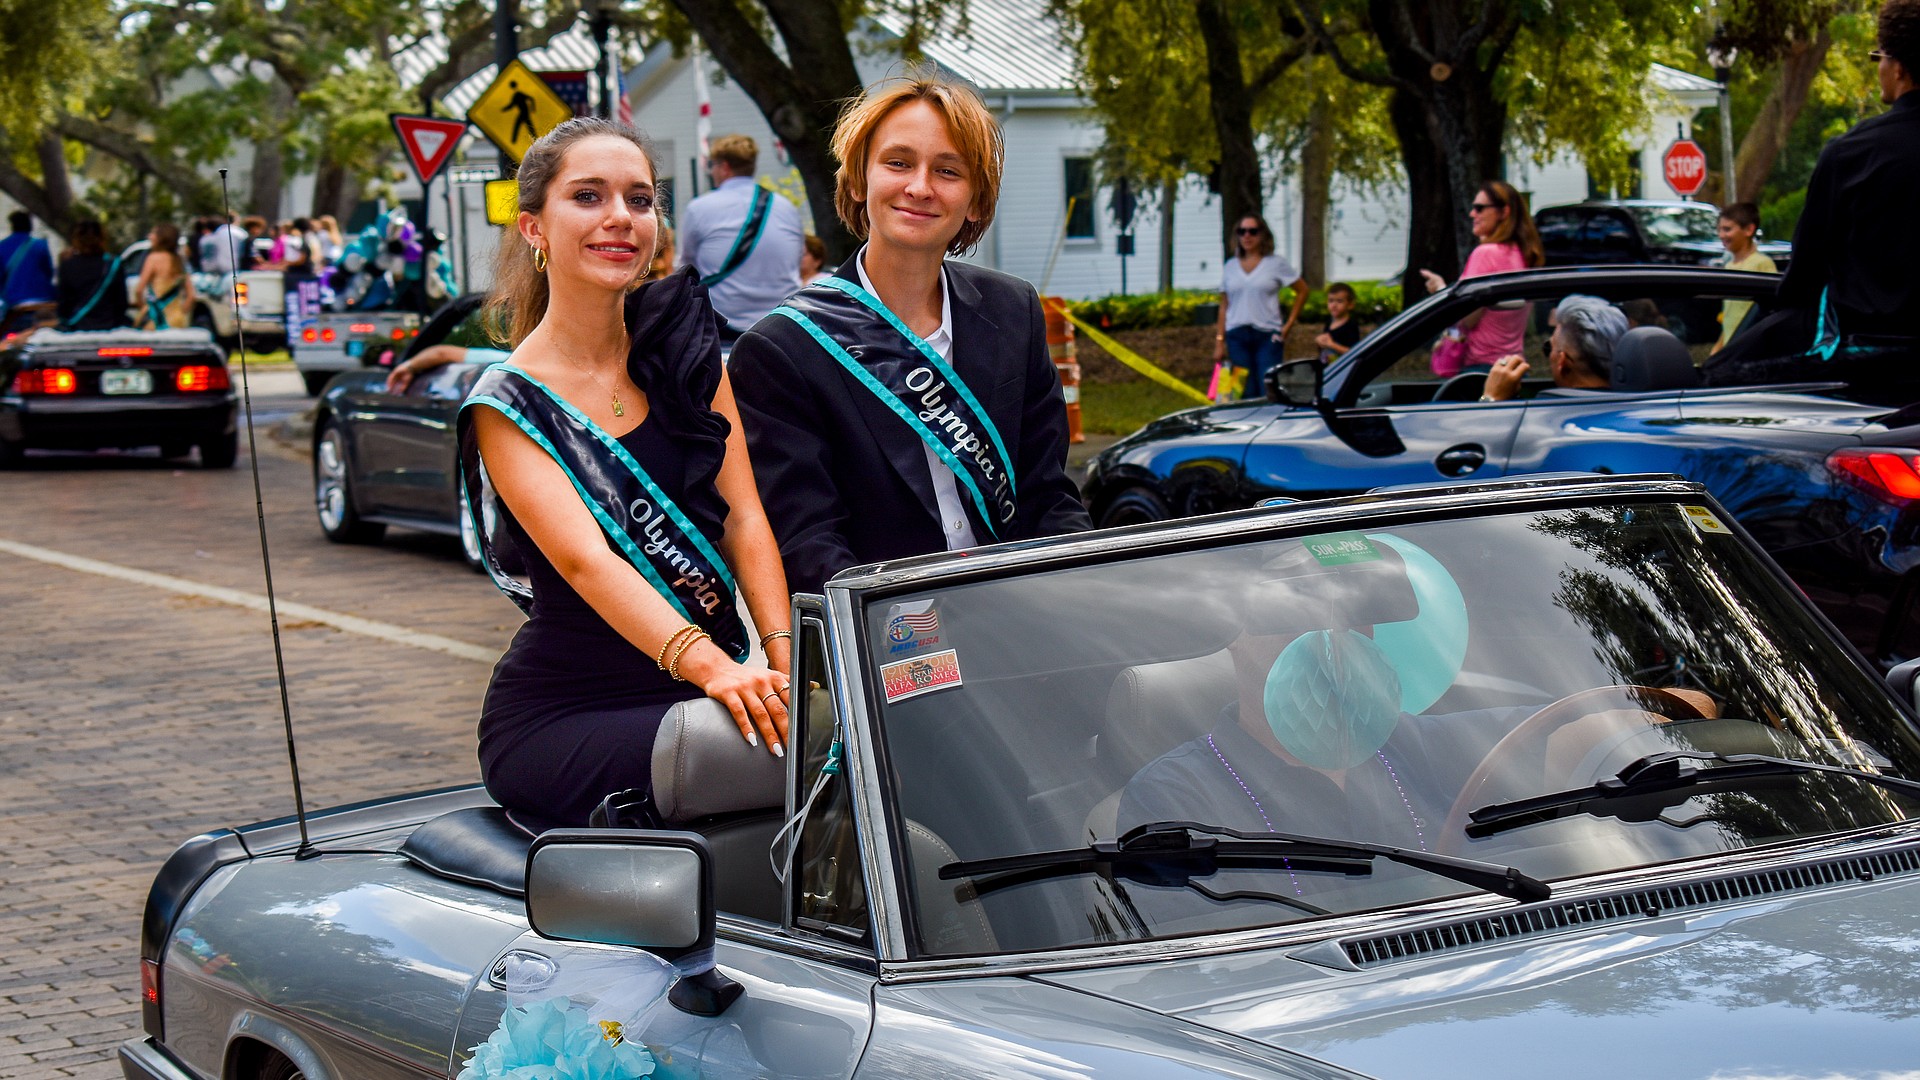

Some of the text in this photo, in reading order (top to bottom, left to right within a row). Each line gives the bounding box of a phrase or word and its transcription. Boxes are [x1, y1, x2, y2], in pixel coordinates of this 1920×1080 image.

[1667, 156, 1701, 179] STOP
[905, 367, 995, 480] Olympia
[630, 498, 720, 616] Olympia
[1311, 543, 1336, 555] SUN
[1340, 540, 1368, 552] PASS
[885, 666, 944, 686] CENTENARIO
[887, 670, 959, 693] ALFA ROMEO
